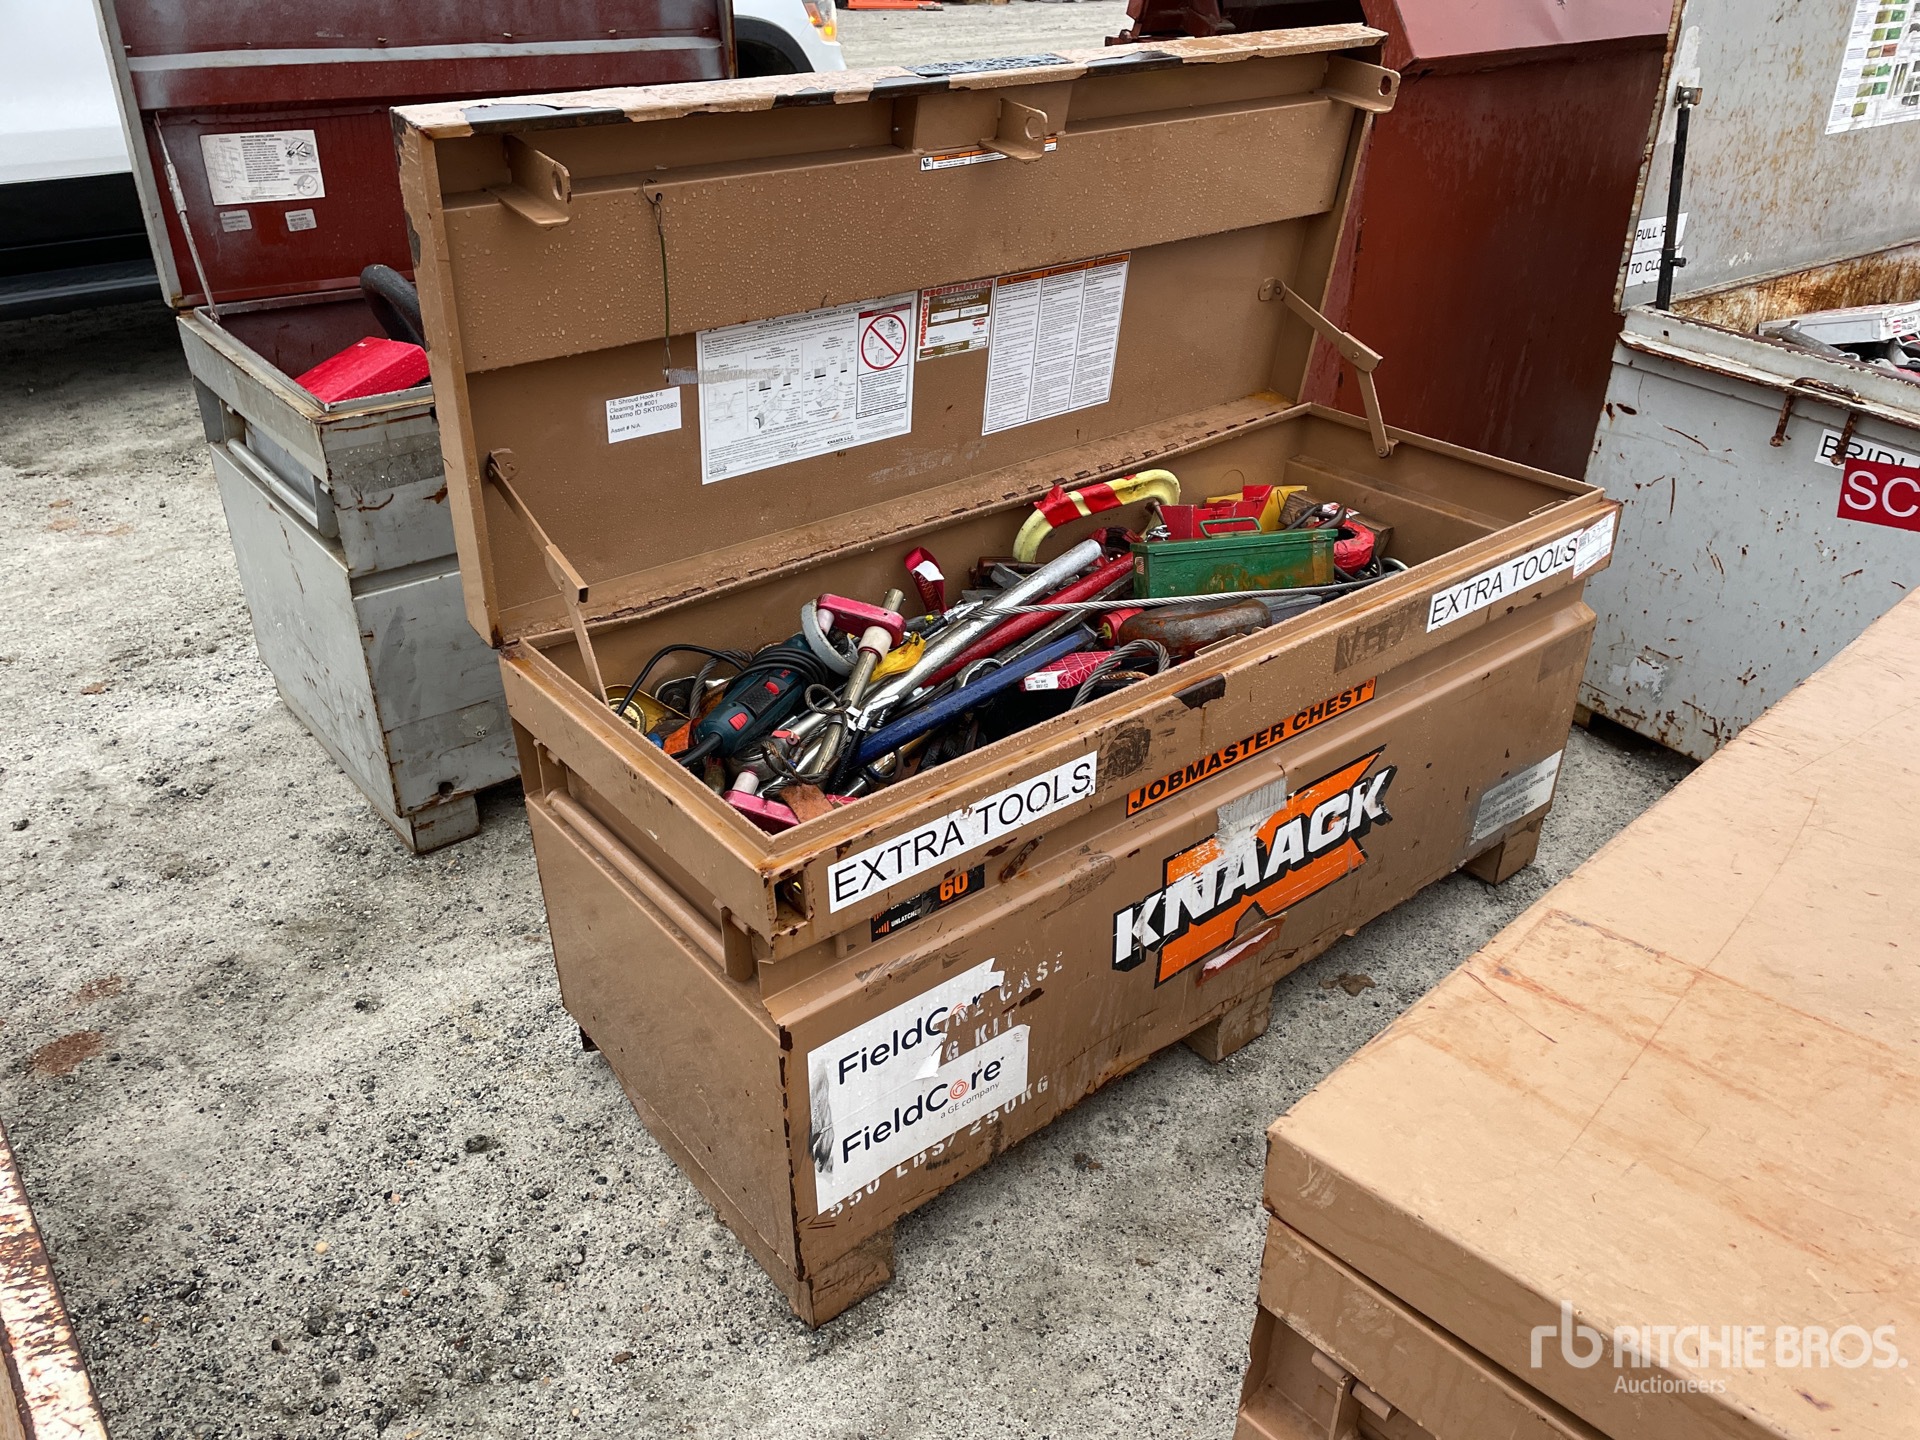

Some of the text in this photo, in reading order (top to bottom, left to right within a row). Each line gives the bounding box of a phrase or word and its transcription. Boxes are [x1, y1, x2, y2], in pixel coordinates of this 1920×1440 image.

[1636, 227, 1657, 241] PULL
[1631, 258, 1661, 275] TO CLO
[923, 280, 993, 298] REGISTRATION
[920, 298, 929, 347] PRODUCT
[609, 404, 634, 414] Cleaning
[618, 396, 638, 405] Shroud
[609, 412, 633, 421] Maximo
[1821, 435, 1920, 466] BRID
[1431, 571, 1503, 625] EXTRA
[1512, 537, 1577, 586] TOOLS
[1131, 721, 1285, 809] JOBMASTER
[834, 762, 1094, 903] EXTRA TOOLS
[1114, 767, 1391, 965] KNAACK
[940, 871, 969, 901] 60
[842, 1060, 1001, 1164] FieldCore
[947, 1104, 960, 1115] GE
[961, 1082, 1000, 1107] company
